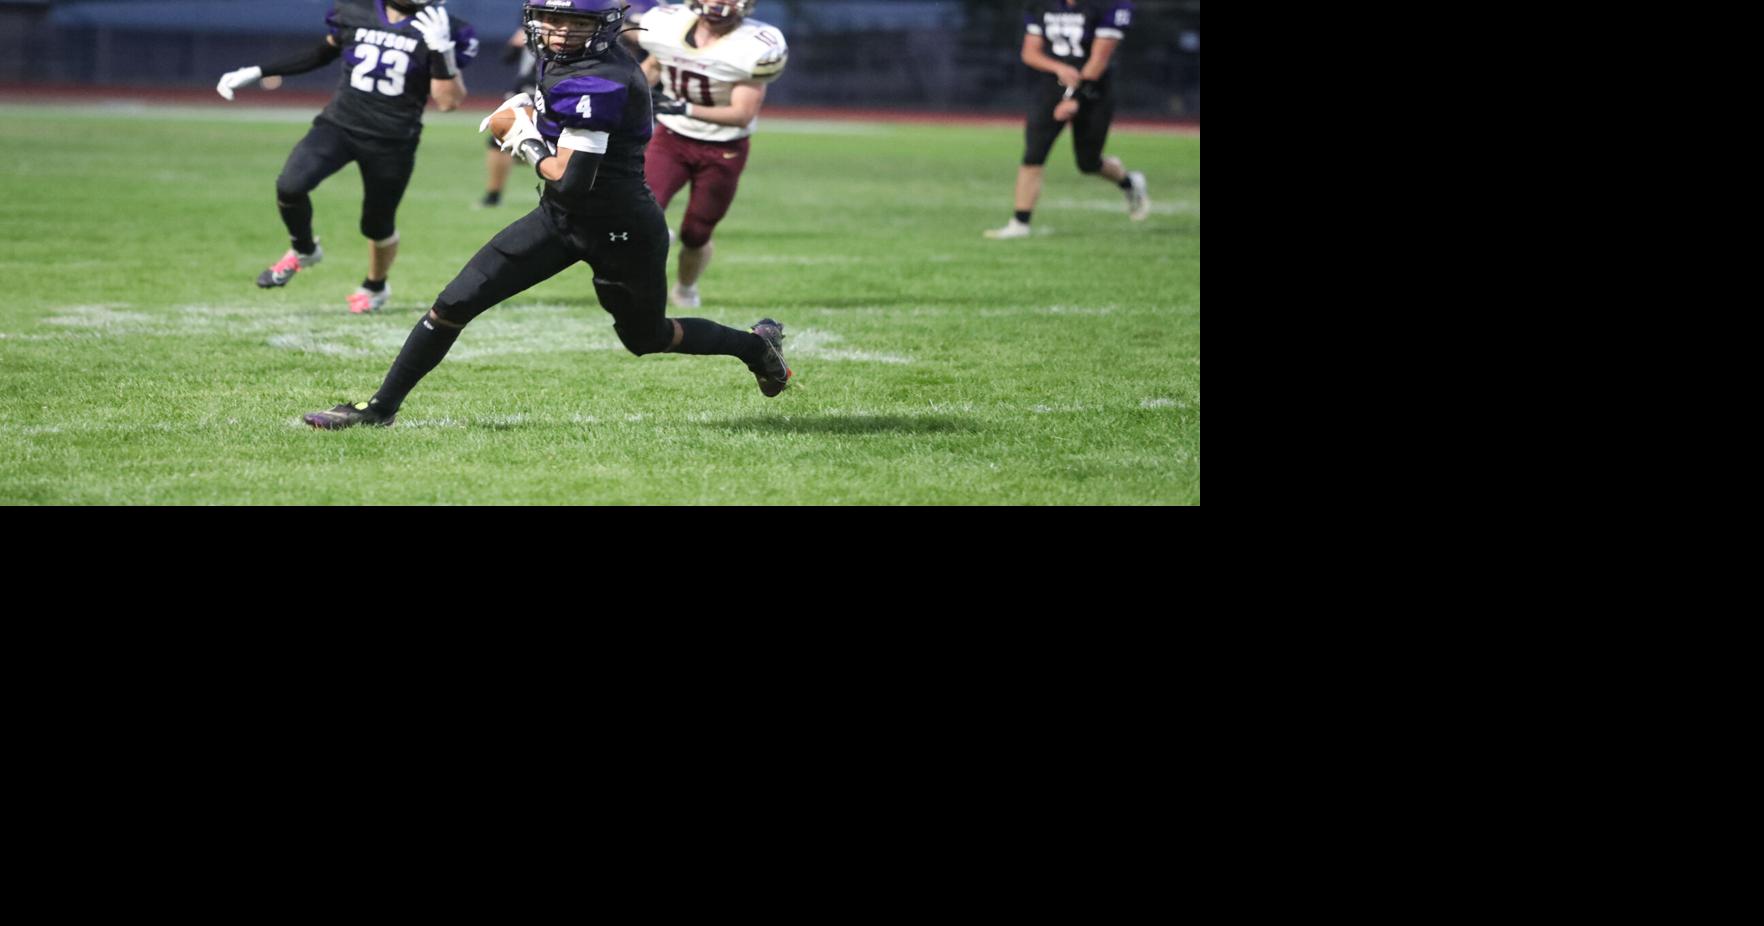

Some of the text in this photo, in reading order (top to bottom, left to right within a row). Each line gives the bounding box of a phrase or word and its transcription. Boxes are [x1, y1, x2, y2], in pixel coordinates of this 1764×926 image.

[354, 28, 418, 53] PAYSON
[350, 43, 410, 97] 23
[667, 65, 715, 107] 10
[575, 94, 592, 119] 4
